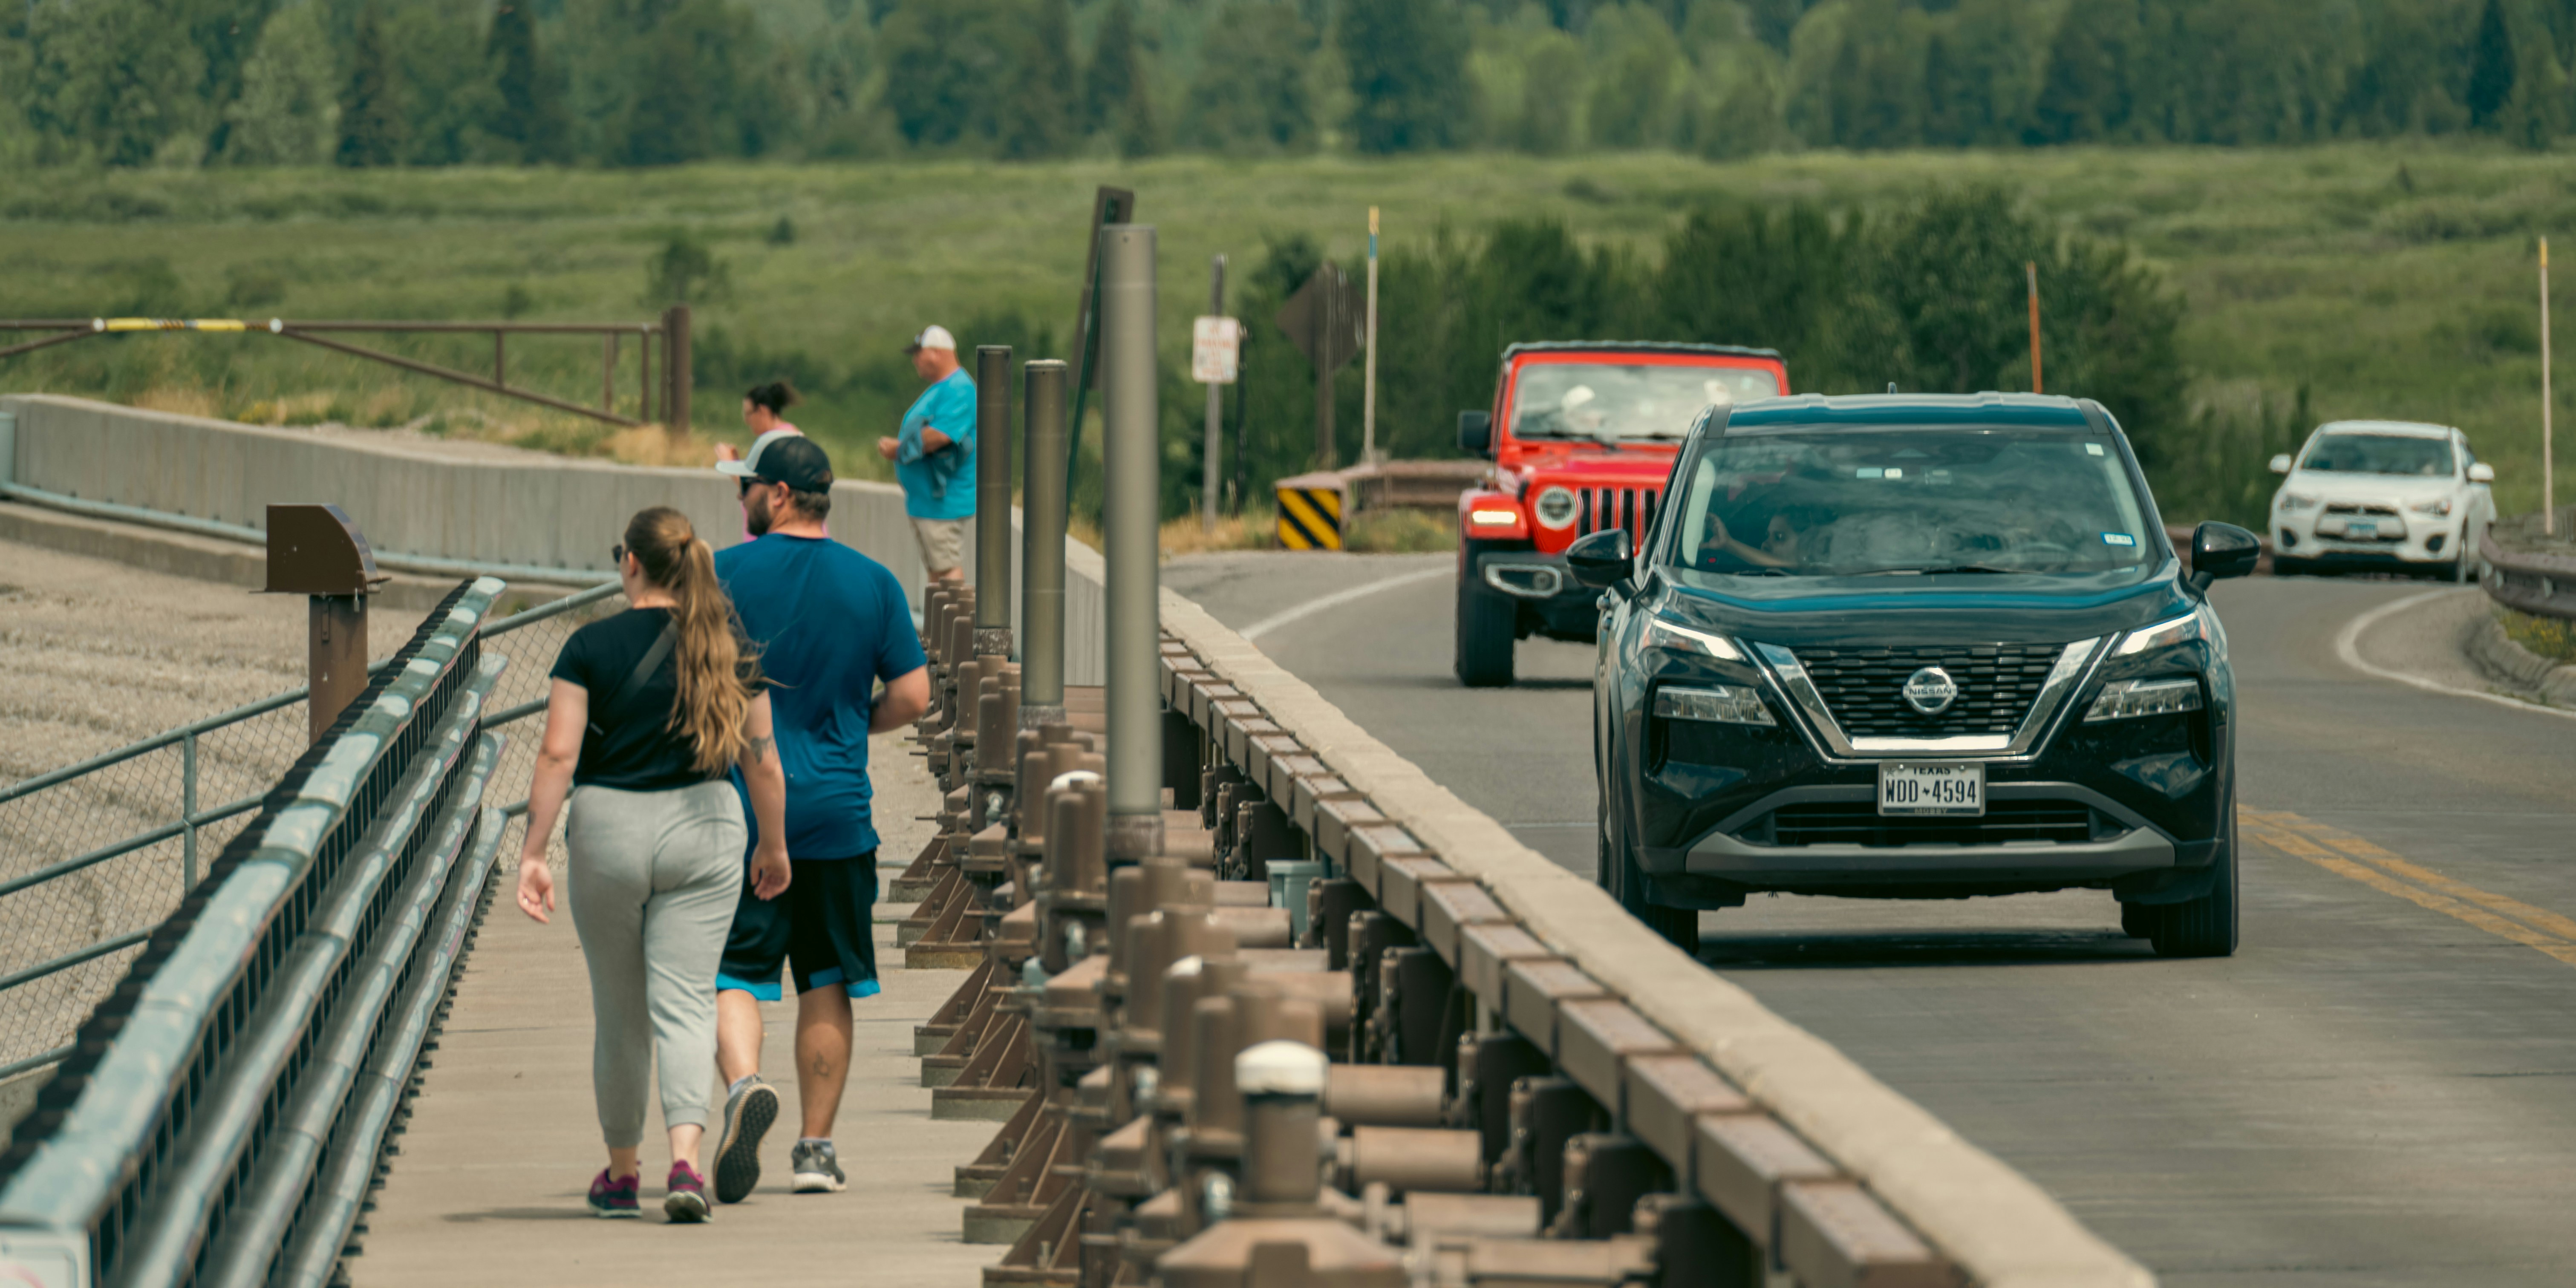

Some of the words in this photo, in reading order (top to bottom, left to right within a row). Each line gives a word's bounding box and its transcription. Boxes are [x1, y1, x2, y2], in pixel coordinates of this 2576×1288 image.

[1913, 767, 1950, 775] TEXAS
[1886, 779, 1918, 803] WDD
[1932, 779, 1976, 803] 4594
